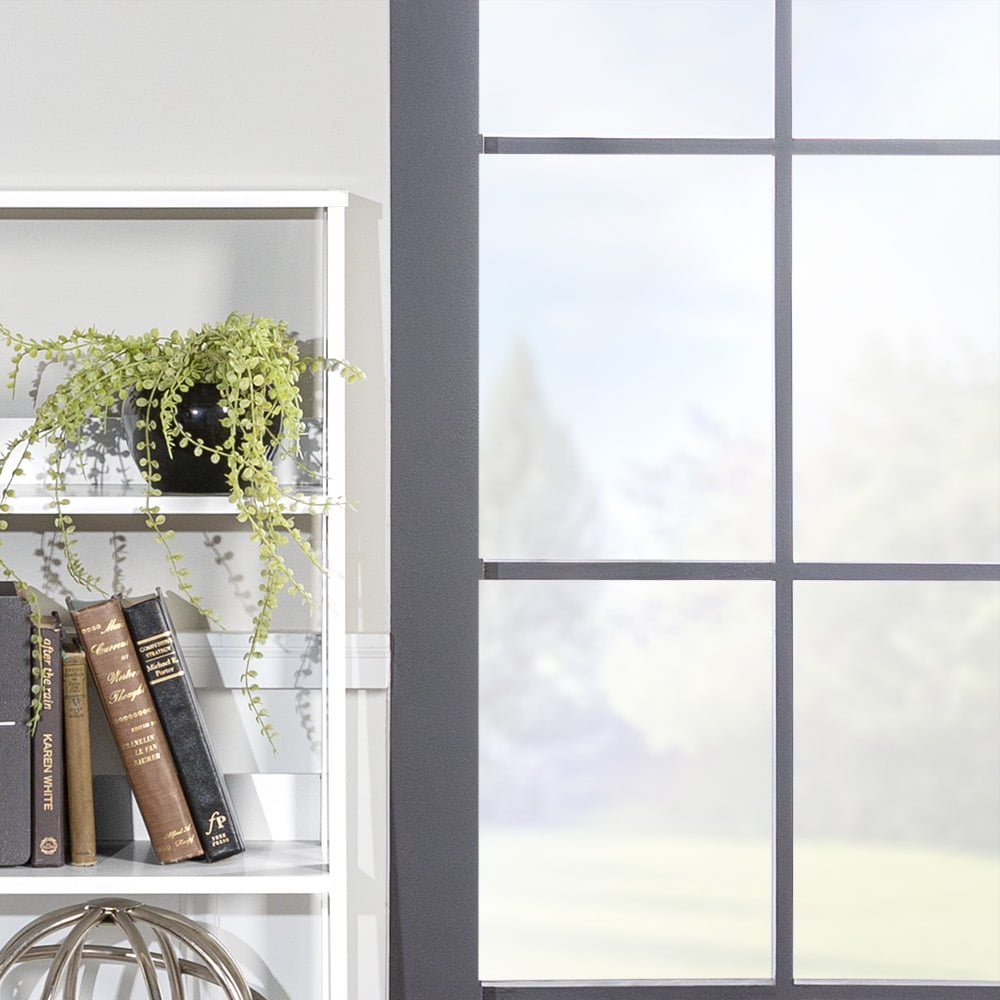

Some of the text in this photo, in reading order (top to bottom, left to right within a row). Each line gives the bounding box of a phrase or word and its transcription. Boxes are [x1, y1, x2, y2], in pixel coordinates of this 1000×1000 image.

[42, 638, 54, 710] after the rain
[155, 667, 175, 677] Porter
[42, 733, 54, 811] KAREN WHITE
